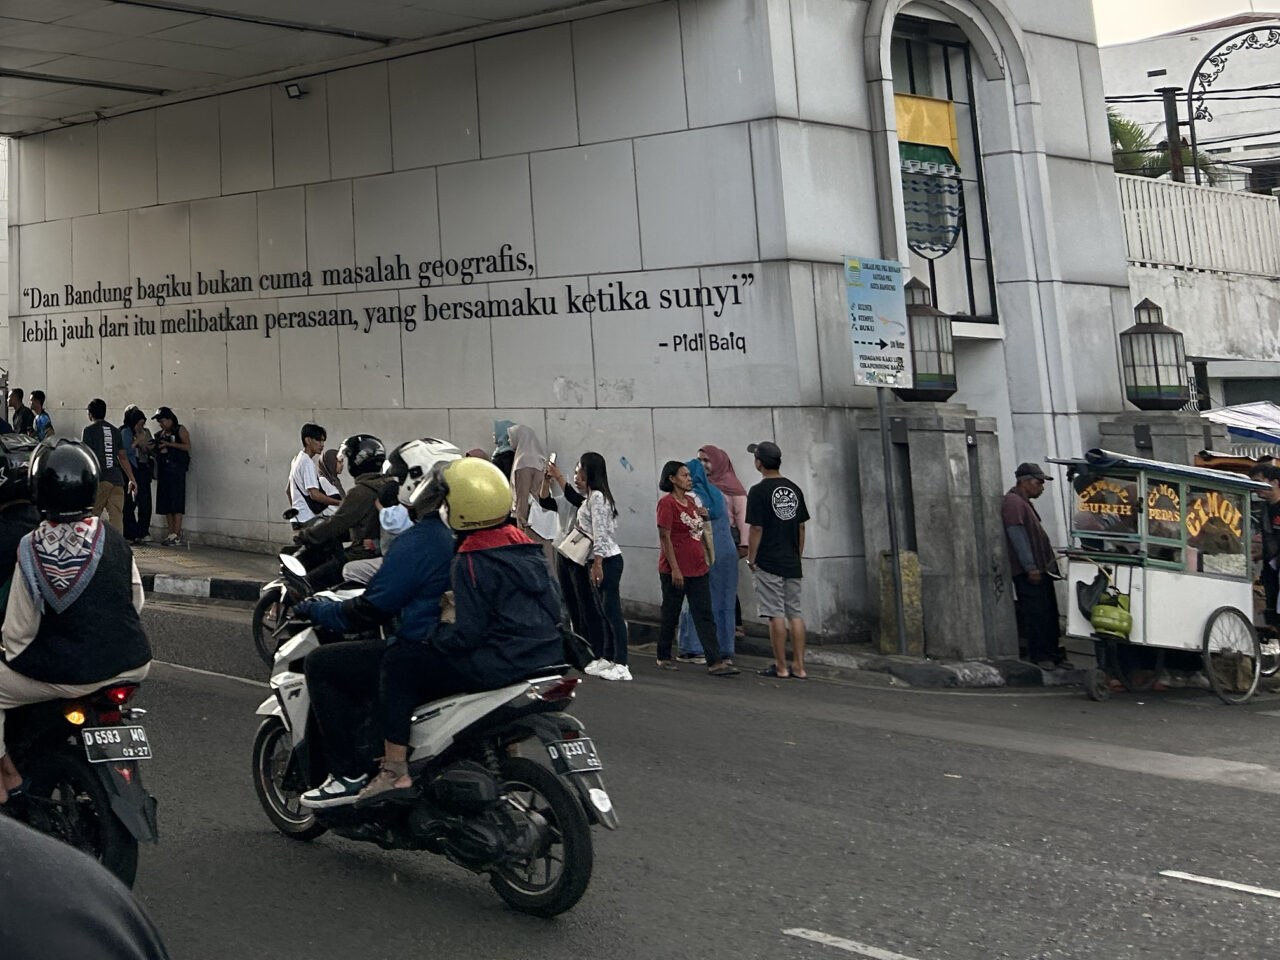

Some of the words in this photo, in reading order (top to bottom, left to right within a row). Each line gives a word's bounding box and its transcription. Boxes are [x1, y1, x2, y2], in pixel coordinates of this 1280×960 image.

[64, 281, 132, 308] Bandung
[136, 274, 192, 306] bagiku
[197, 269, 253, 295] bukan
[259, 270, 313, 290] cuma
[321, 254, 411, 286] masalah
[418, 243, 534, 288] geografis,
[21, 320, 58, 343] lebih
[60, 316, 94, 348] jauh
[98, 315, 129, 338] dari
[134, 313, 156, 336] itu
[160, 306, 259, 334] melibatkan
[264, 306, 359, 338] perasaan,
[363, 303, 417, 333] yang
[422, 287, 559, 321] bersamaku
[565, 281, 651, 314] ketika
[672, 333, 704, 352] Pidi
[709, 331, 746, 354] Baiq
[1078, 479, 1129, 504] CIMOL
[1148, 483, 1180, 509] CIMOL
[1078, 502, 1132, 515] GURIH
[1148, 508, 1181, 522] PEDAS
[1185, 491, 1243, 538] CIMOL
[84, 732, 93, 745] D
[94, 730, 121, 744] 6583
[548, 746, 559, 760] D
